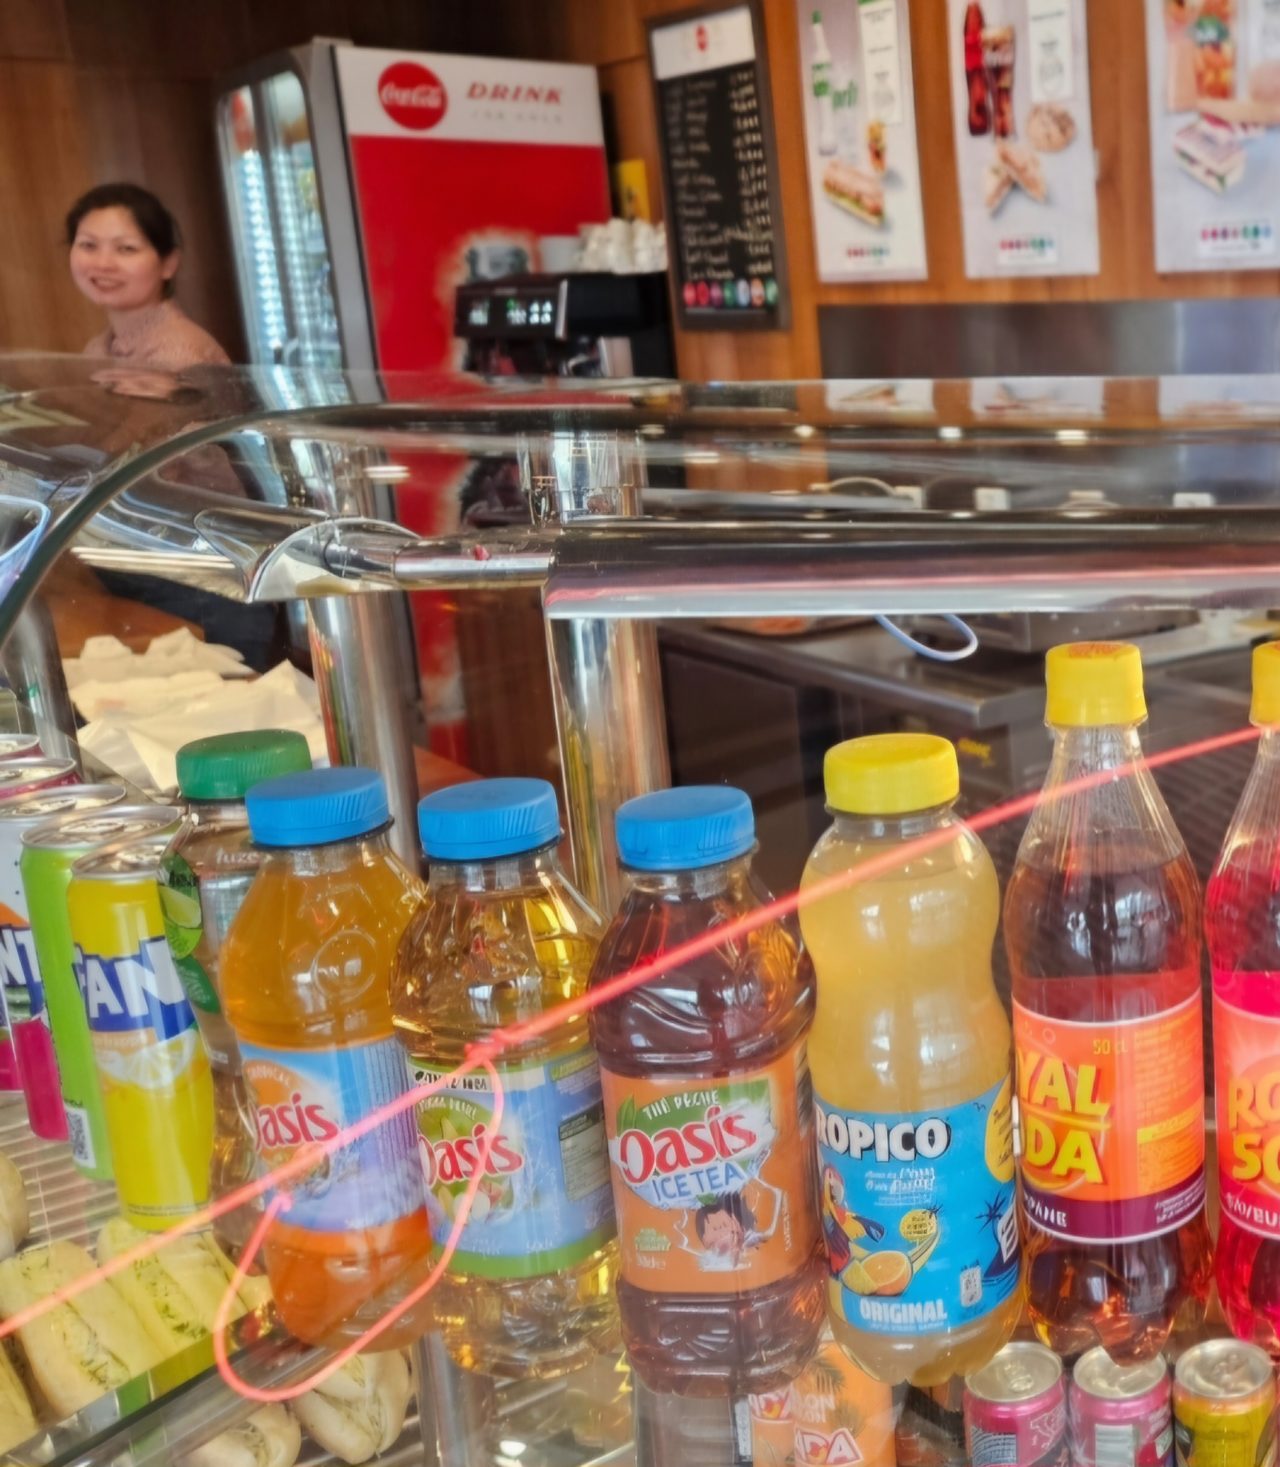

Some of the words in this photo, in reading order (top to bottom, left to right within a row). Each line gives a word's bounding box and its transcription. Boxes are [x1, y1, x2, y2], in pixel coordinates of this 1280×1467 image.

[466, 82, 563, 104] DRINK
[252, 1093, 339, 1153] asis
[619, 1105, 757, 1184] Oasis
[652, 1170, 690, 1201] ICE
[694, 1162, 745, 1193] TEA
[859, 1298, 948, 1324] ORIGINAL
